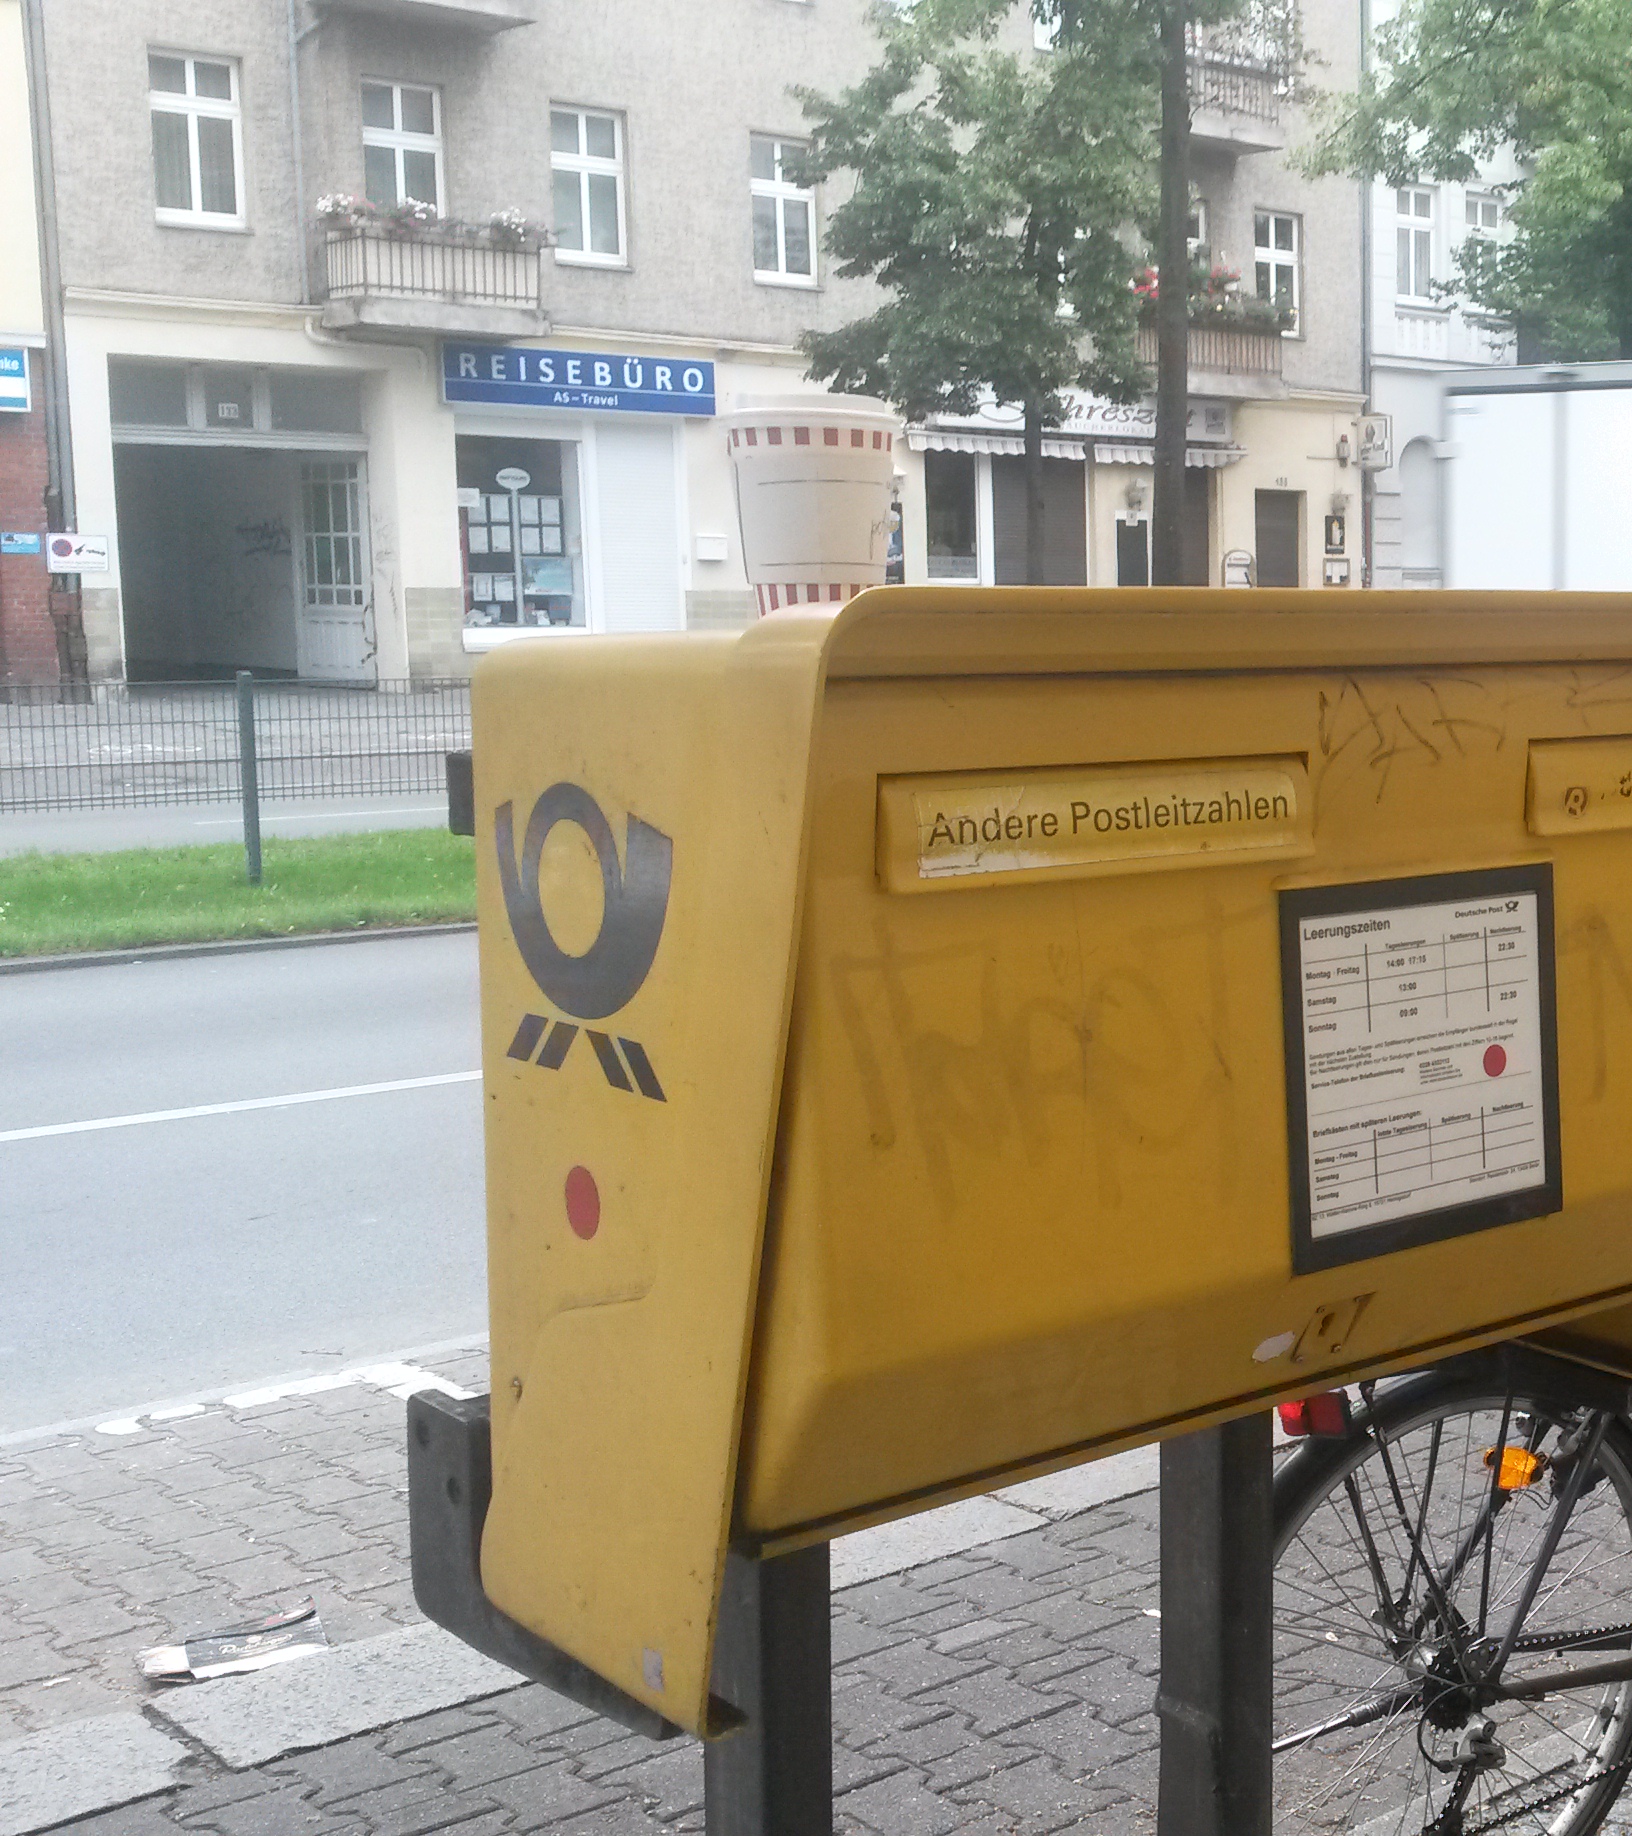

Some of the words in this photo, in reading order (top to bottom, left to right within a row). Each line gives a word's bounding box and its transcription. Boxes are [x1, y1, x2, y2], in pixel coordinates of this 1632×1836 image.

[459, 352, 704, 392] REISEBÜRO
[928, 807, 1060, 848] Andere
[1069, 789, 1290, 835] Postleitzahlen
[1455, 907, 1488, 919] Deutsche
[1489, 905, 1503, 914] Post
[1303, 919, 1391, 941] Leerungszeiten
